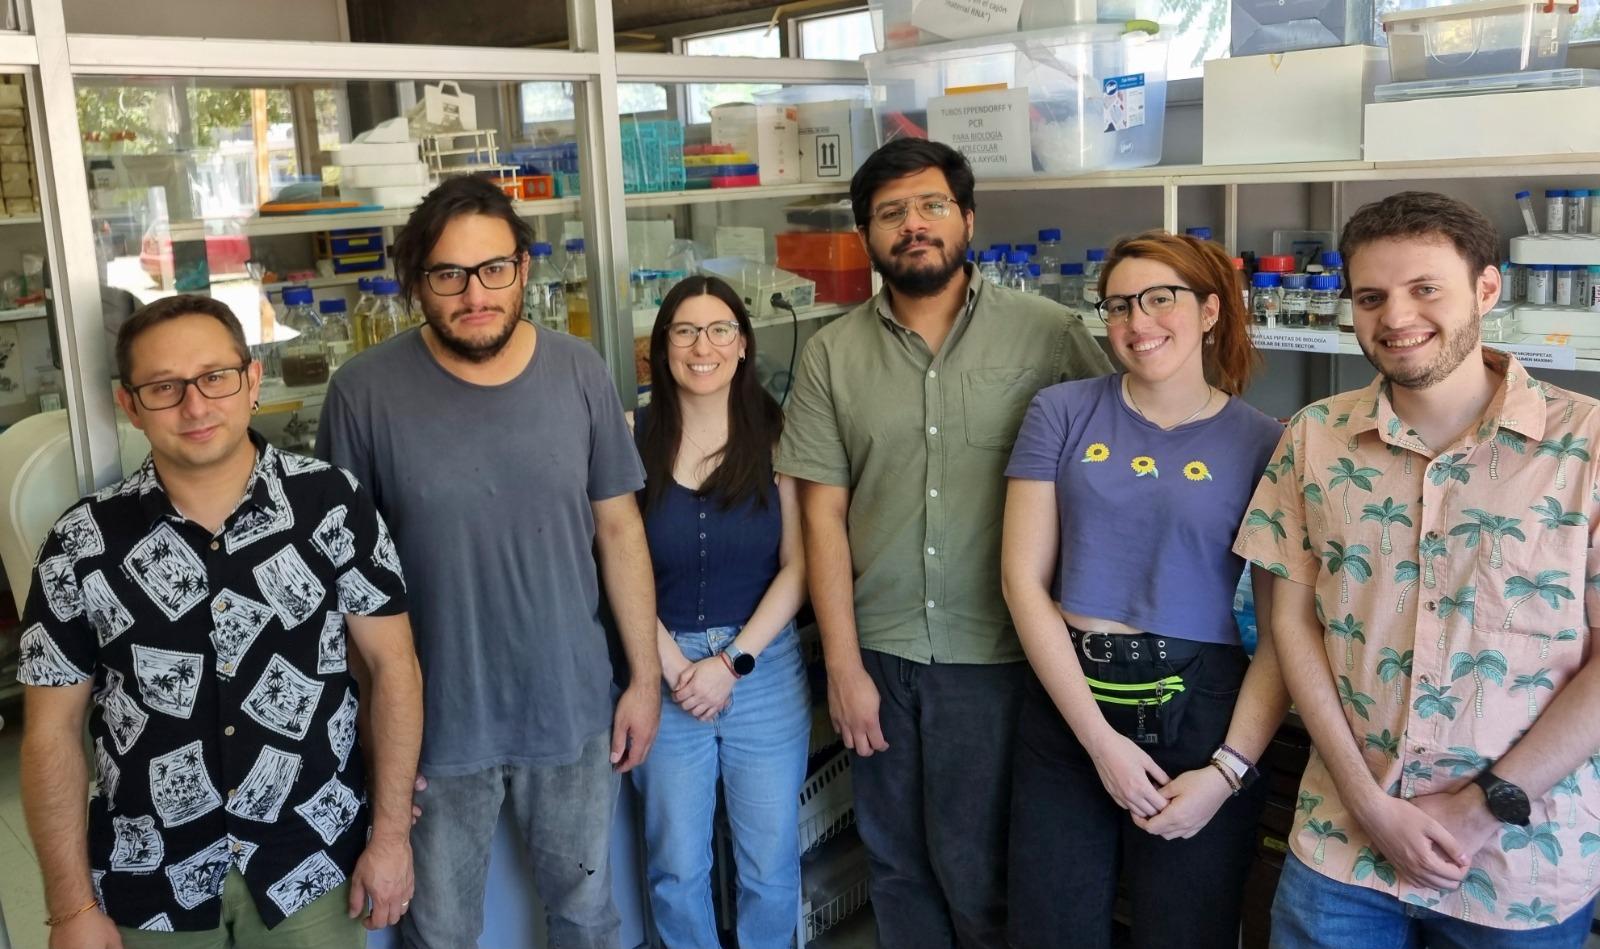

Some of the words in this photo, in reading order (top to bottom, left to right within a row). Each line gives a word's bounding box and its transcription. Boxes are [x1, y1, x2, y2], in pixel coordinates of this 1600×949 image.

[963, 104, 1006, 115] EPPENDORFF
[1007, 103, 1013, 111] Y
[968, 119, 983, 128] PCR
[971, 128, 1003, 140] BIOLOGÍA
